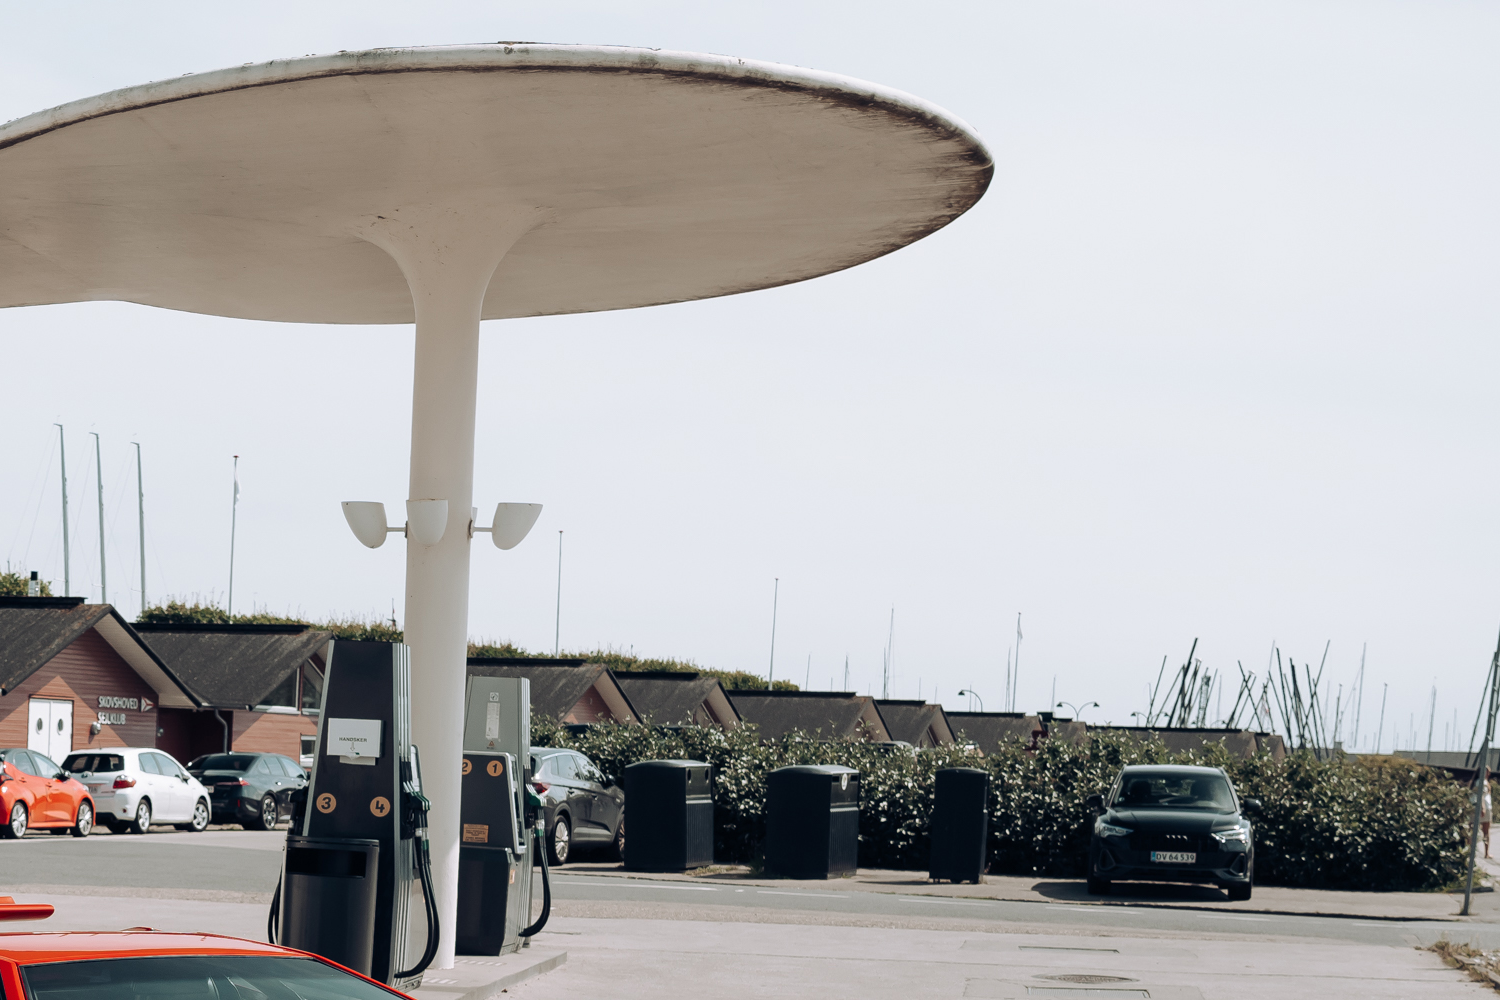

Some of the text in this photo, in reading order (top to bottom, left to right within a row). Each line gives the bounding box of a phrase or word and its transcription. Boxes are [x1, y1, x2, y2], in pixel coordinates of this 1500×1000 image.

[461, 761, 498, 774] 2 1
[321, 796, 385, 813] 3 4
[1156, 853, 1167, 861] DV
